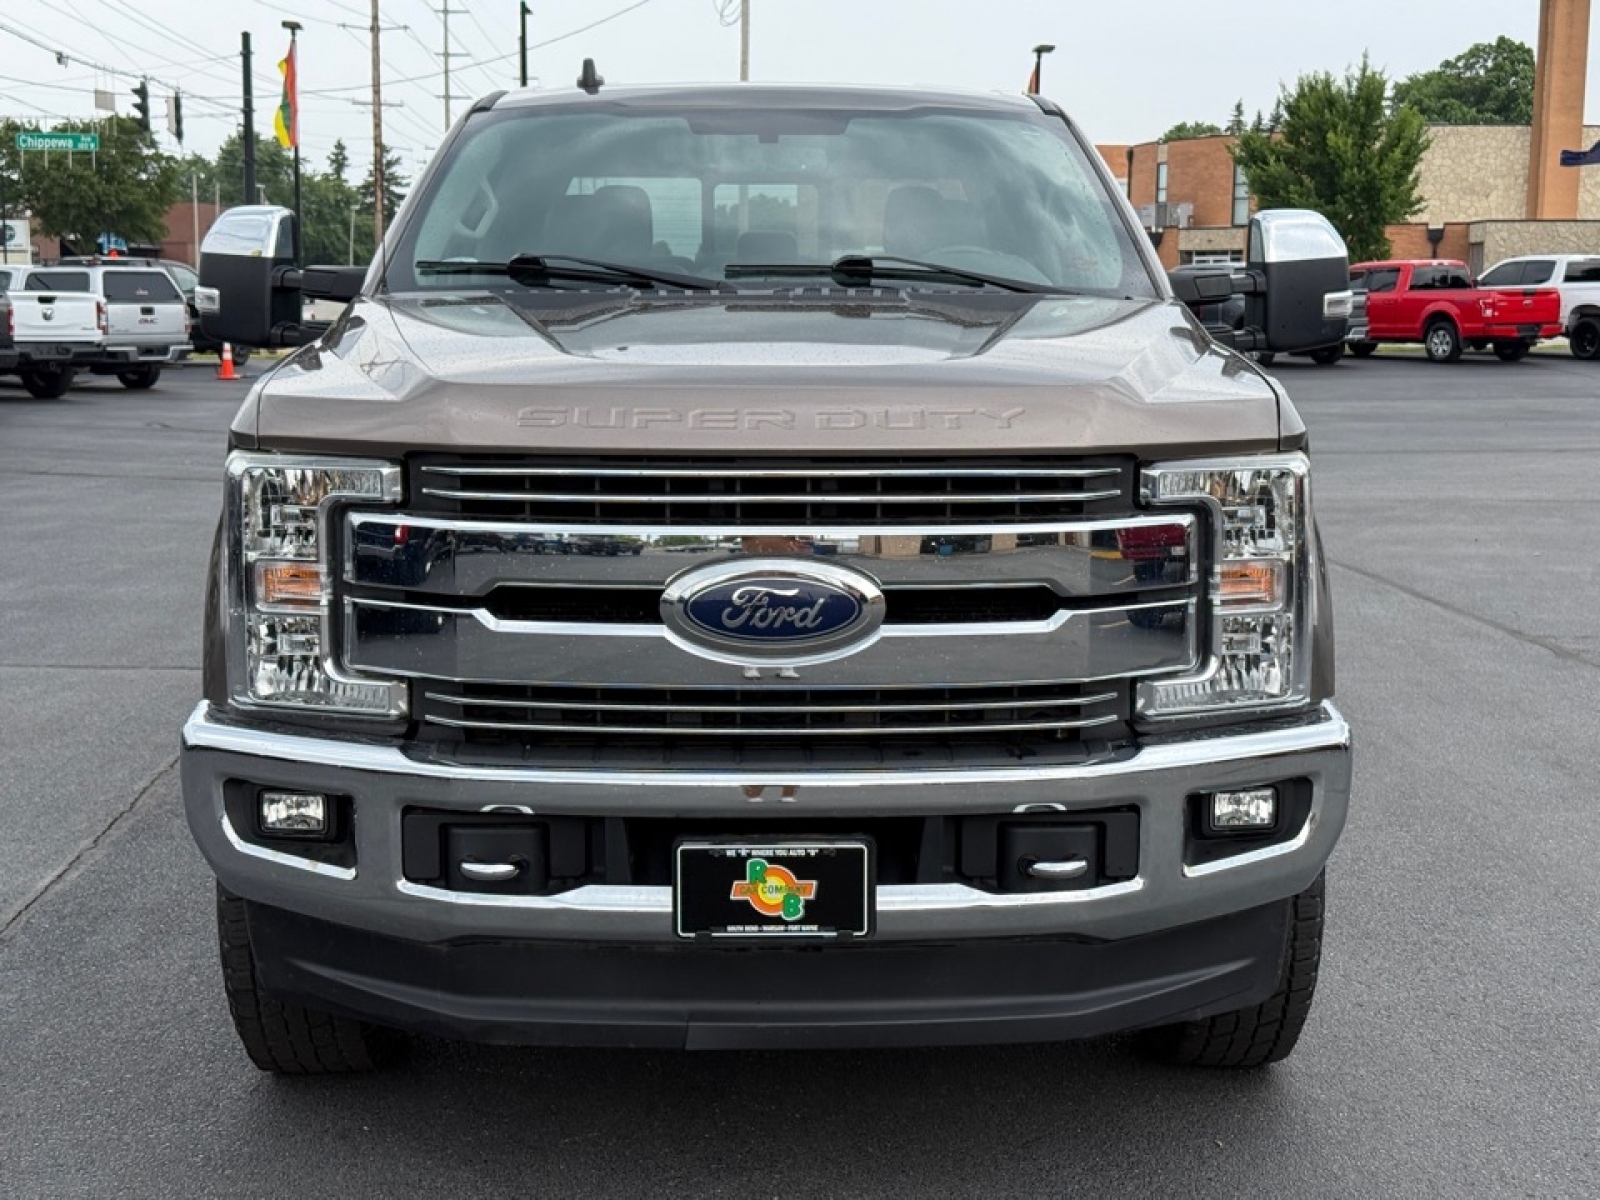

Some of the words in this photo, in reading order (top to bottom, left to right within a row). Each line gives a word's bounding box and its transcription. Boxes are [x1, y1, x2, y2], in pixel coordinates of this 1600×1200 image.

[19, 134, 74, 149] Chippewa
[516, 406, 795, 430] SUPER
[814, 406, 1026, 430] DUTY
[721, 586, 824, 629] Ford
[747, 858, 768, 884] R
[782, 893, 805, 920] B
